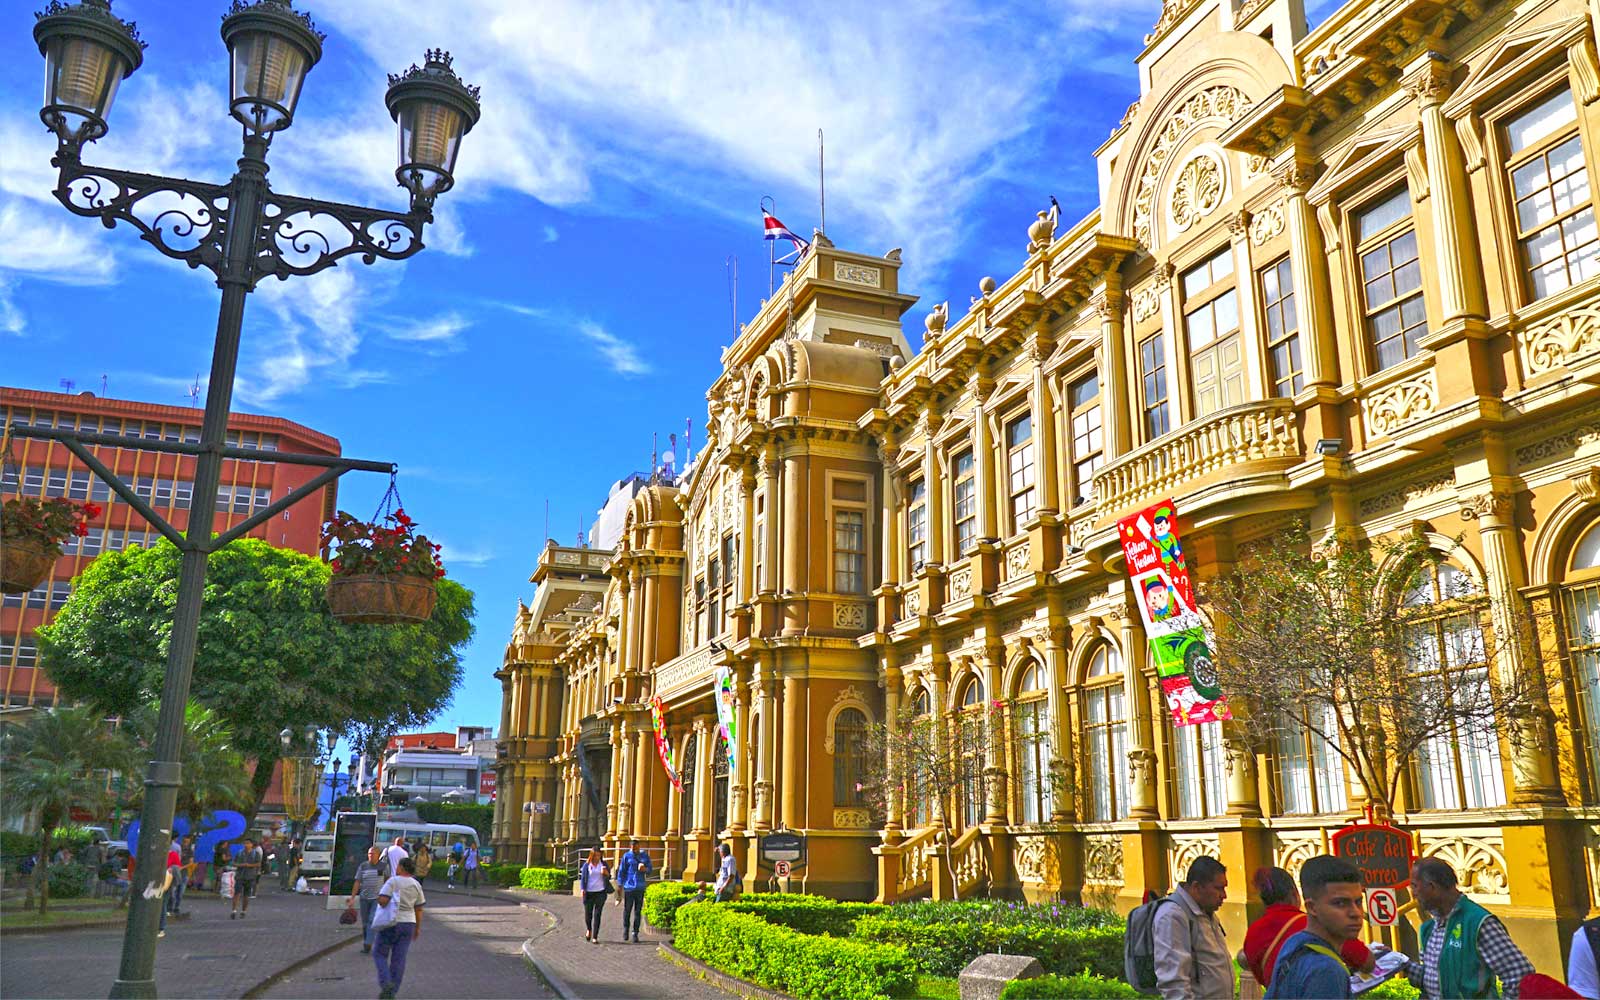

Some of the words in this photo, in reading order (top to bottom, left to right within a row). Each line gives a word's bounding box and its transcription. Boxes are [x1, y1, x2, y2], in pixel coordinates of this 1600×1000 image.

[1345, 831, 1378, 863] Café
[1384, 833, 1405, 858] del
[1359, 867, 1398, 884] orreo
[1376, 895, 1389, 919] E
